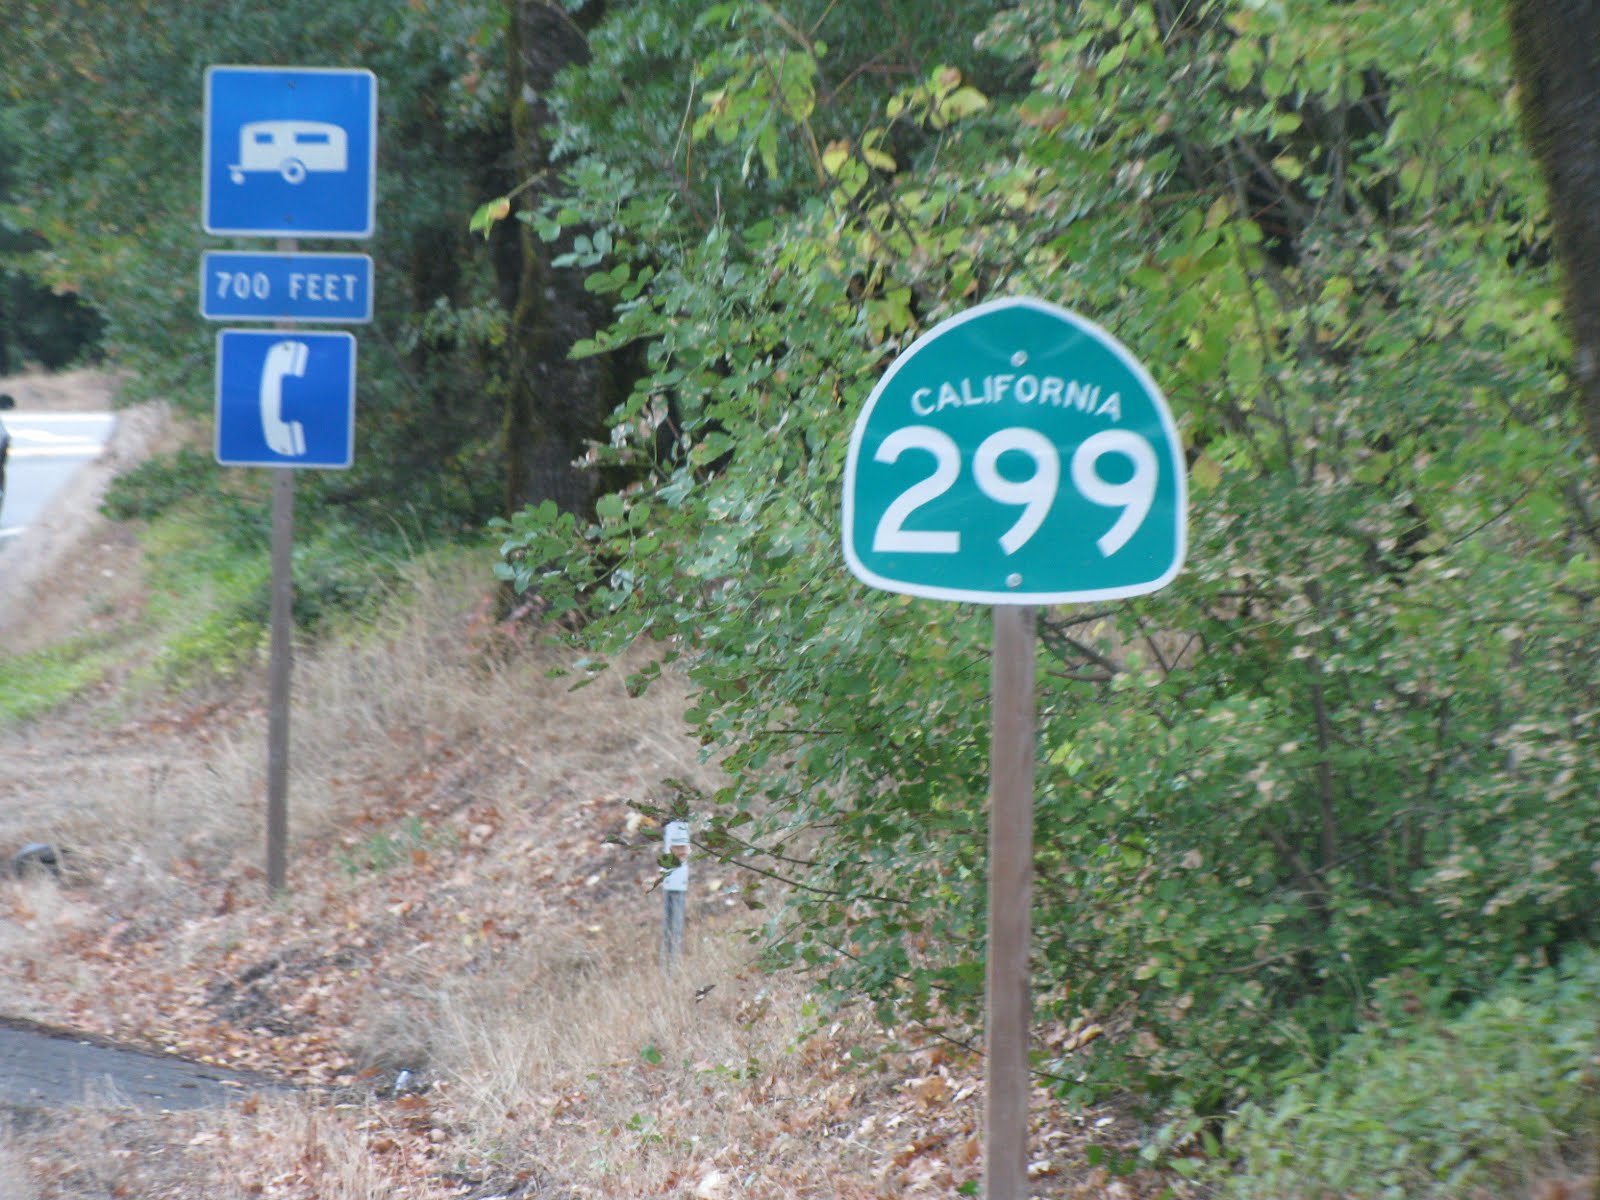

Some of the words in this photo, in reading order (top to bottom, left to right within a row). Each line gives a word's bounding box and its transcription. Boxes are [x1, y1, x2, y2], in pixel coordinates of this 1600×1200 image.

[215, 272, 271, 300] 700
[289, 273, 358, 302] FEET
[911, 374, 1122, 423] CALIFORNIA
[872, 425, 1159, 559] 299
